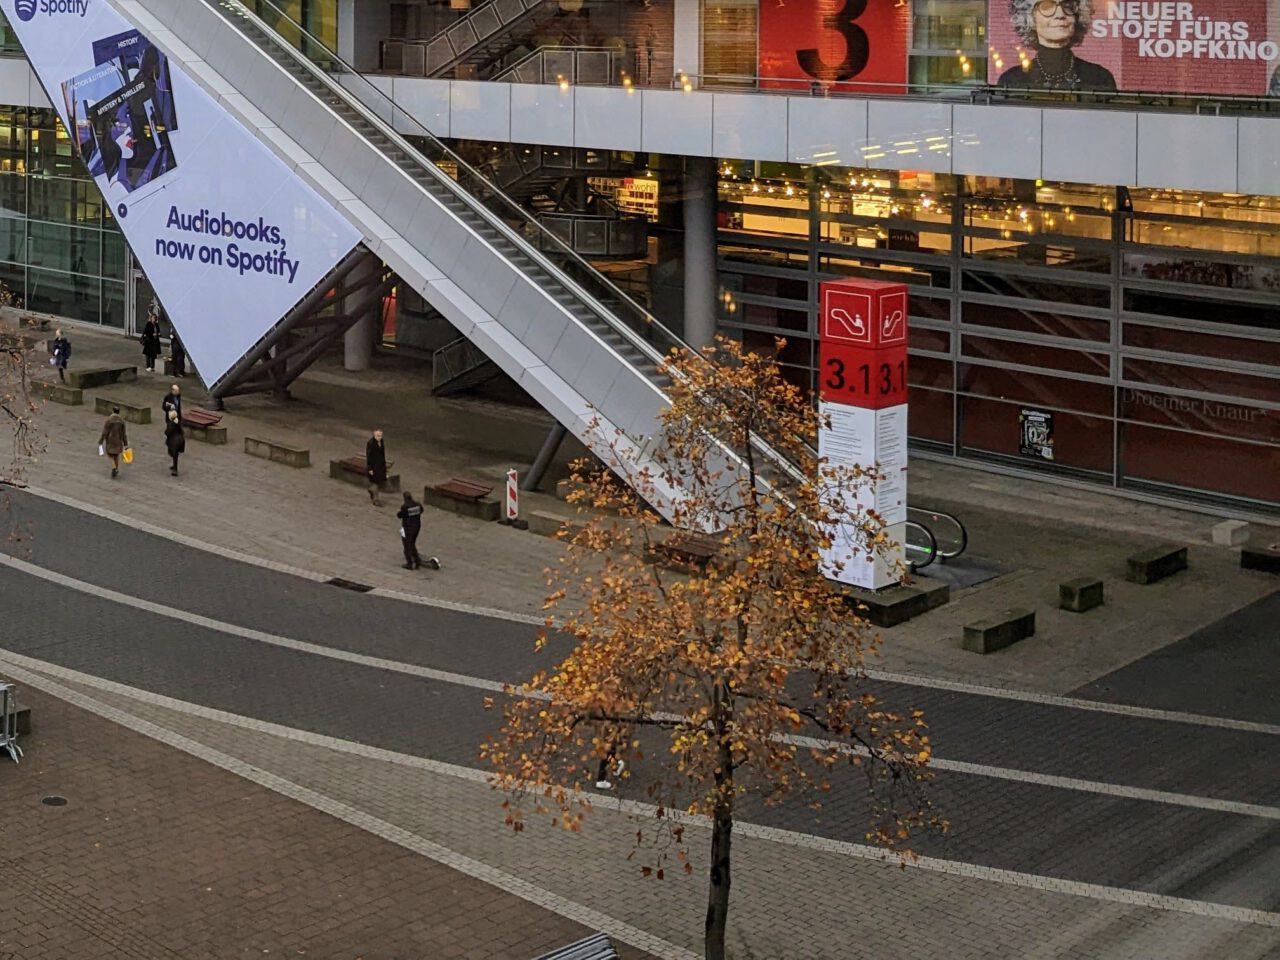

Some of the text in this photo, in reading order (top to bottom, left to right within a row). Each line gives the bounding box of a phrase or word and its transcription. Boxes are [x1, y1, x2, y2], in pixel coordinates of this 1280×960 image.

[1107, 1, 1193, 20] NEUER
[118, 36, 138, 48] HISTORY
[1092, 16, 1249, 40] STOFF FÜRS
[1139, 39, 1279, 60] KOPFKINO
[97, 99, 118, 115] MYSTERY
[121, 82, 145, 100] THRILLERS
[166, 205, 287, 248] Audiobooks,
[155, 236, 300, 284] now on Spotify
[826, 358, 870, 395] 3.1
[880, 360, 905, 395] 3.1
